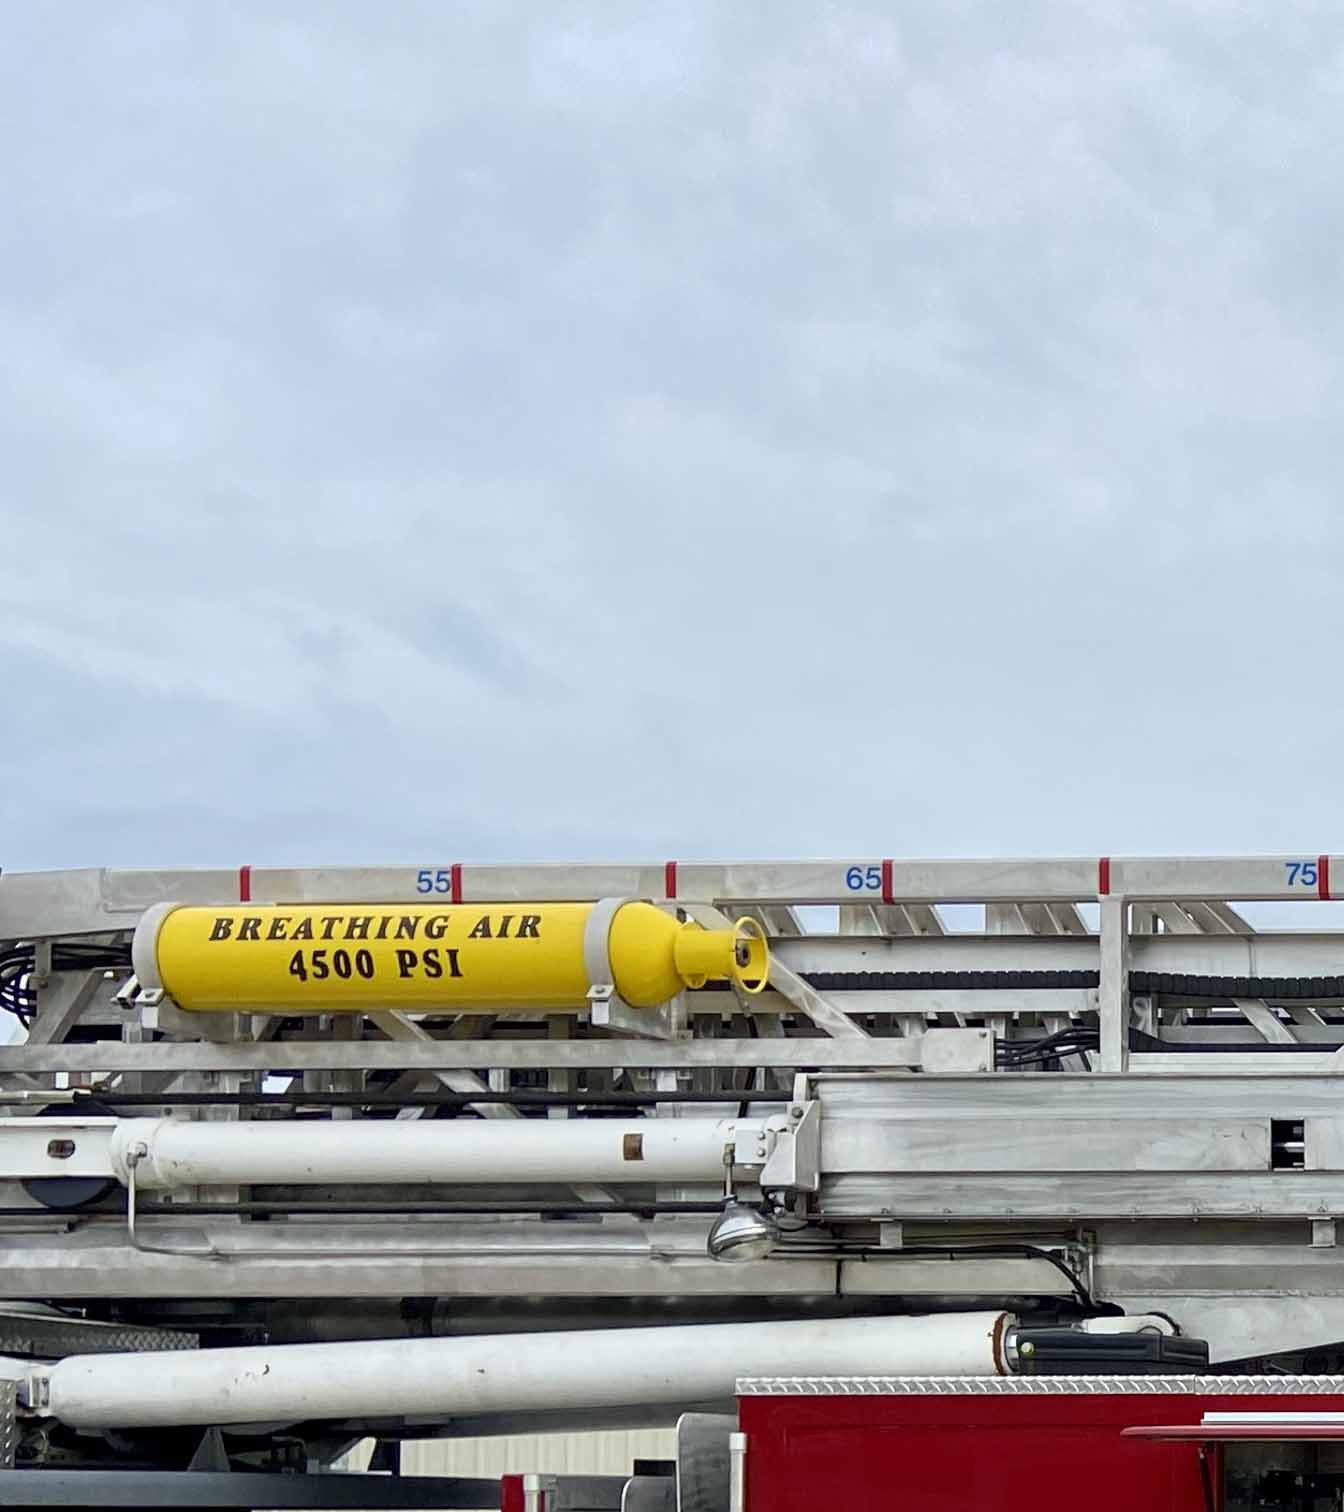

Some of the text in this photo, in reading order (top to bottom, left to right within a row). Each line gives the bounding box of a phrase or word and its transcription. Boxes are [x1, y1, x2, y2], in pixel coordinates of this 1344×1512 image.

[415, 869, 451, 894] 55
[846, 866, 882, 891] 65
[1284, 862, 1318, 886] 75
[208, 914, 543, 942] BREATHING AIR
[288, 948, 465, 983] 4500 PSI
